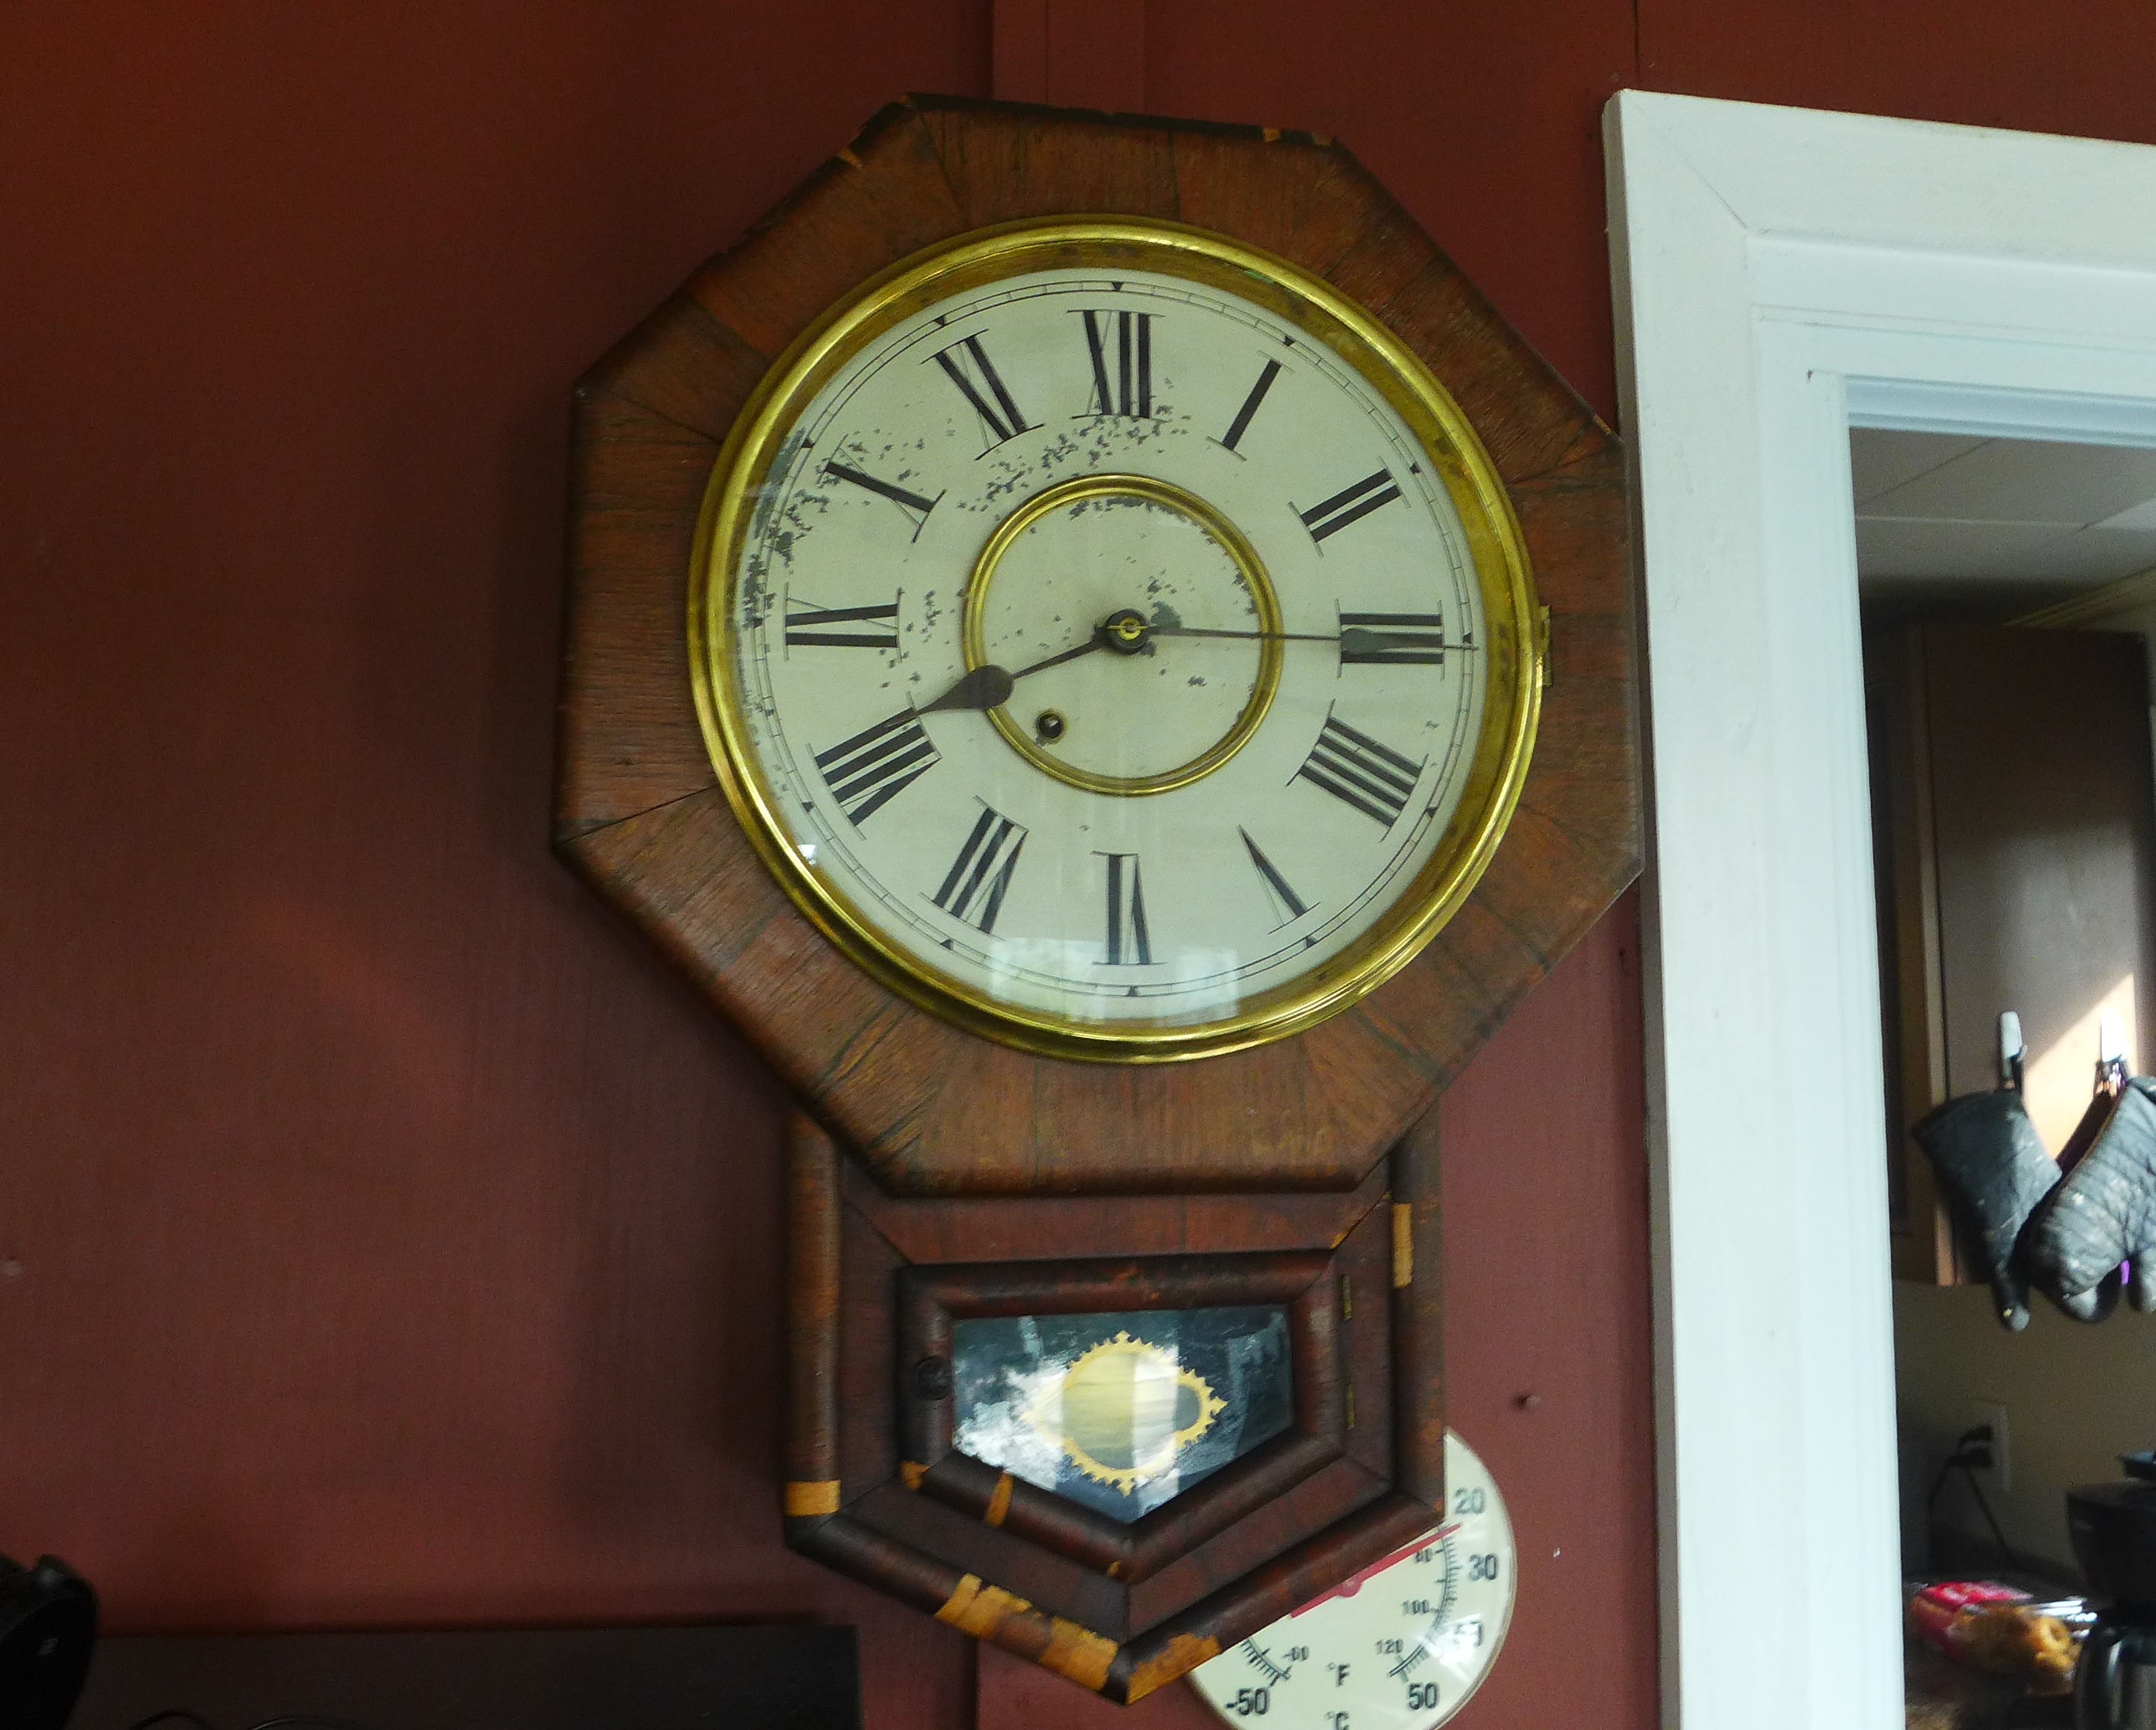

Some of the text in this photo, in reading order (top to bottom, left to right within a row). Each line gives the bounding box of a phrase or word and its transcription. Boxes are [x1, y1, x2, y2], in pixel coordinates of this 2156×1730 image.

[920, 329, 1045, 461] XI
[1067, 309, 1166, 422] XII
[1206, 350, 1295, 462] I
[816, 433, 947, 543] X
[1288, 455, 1411, 558] II
[784, 583, 903, 663] IX
[1335, 598, 1445, 680] III
[806, 691, 943, 841] VIII
[1286, 698, 1430, 843] IIII
[918, 795, 1029, 942] VII
[1091, 850, 1168, 967] VI
[1238, 825, 1321, 935] V
[1454, 1487, 1486, 1515] 20
[1401, 1599, 1431, 1617] 100
[1468, 1553, 1500, 1582] 30
[1374, 1638, 1404, 1656] 120
[1407, 1682, 1439, 1711] 50
[1224, 1687, 1271, 1717] -50
